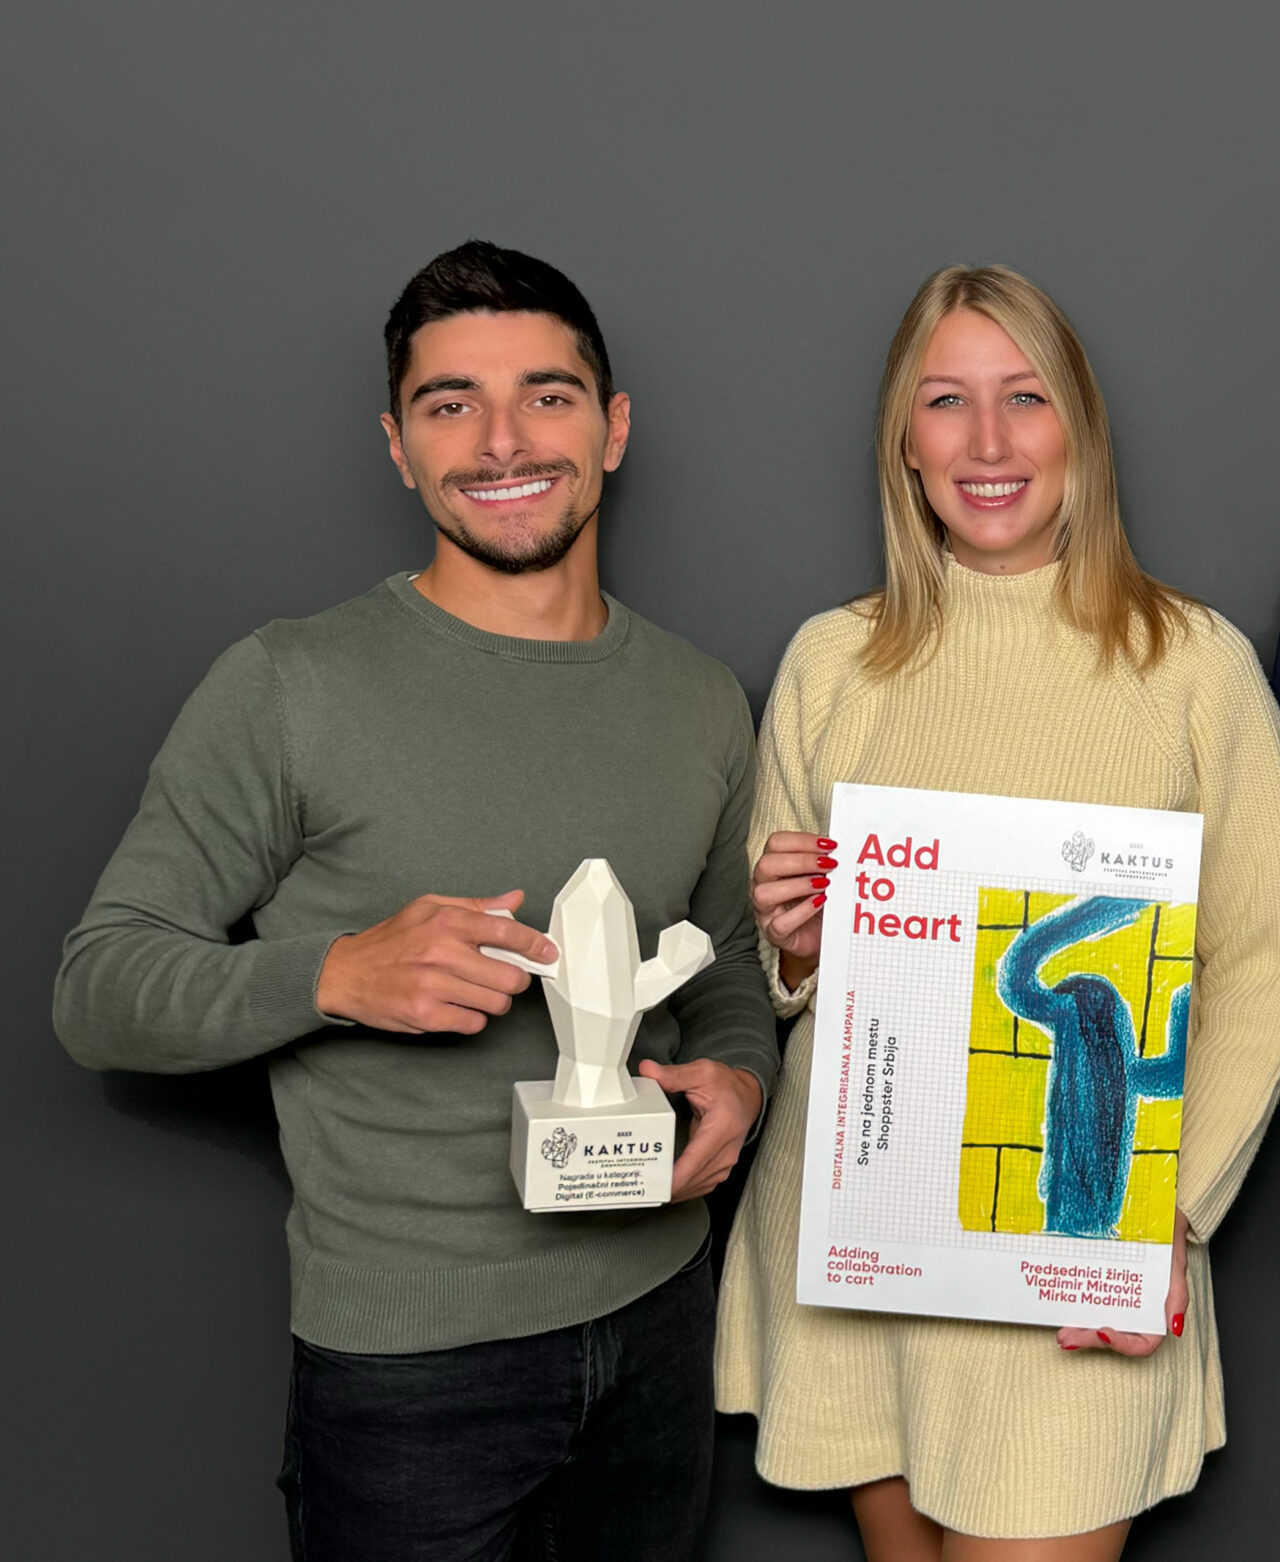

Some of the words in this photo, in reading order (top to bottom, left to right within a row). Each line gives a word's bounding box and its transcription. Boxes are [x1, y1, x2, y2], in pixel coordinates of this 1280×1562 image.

[857, 833, 940, 870] Add
[1101, 852, 1173, 869] KAKTUS
[856, 871, 895, 901] to
[853, 903, 962, 942] heart
[843, 990, 855, 1050] KAMPANJA
[868, 1018, 879, 1060] mestu
[883, 1037, 899, 1076] Srbija
[837, 1054, 850, 1126] INTEGRISANA
[862, 1064, 876, 1117] jednom
[877, 1082, 893, 1150] Shoppster
[862, 1119, 871, 1137] na
[584, 1142, 662, 1156] KAKTUS
[833, 1131, 845, 1190] DIGITALNA
[858, 1140, 870, 1166] Sve
[558, 1182, 608, 1191] Pojedinačni
[611, 1180, 638, 1188] radovi
[560, 1174, 594, 1182] Nagrada
[556, 1192, 583, 1201] Digital
[828, 1246, 879, 1263] Adding
[827, 1259, 922, 1276] collaboration
[827, 1272, 841, 1283] to
[845, 1274, 874, 1286] cart
[1021, 1261, 1102, 1279] Predsednici
[1106, 1268, 1143, 1284] žirija:
[1025, 1275, 1083, 1290] Vladimir
[1087, 1280, 1142, 1295] Mitrović
[1039, 1289, 1076, 1303] Mirka
[1081, 1292, 1141, 1308] Modrinić
